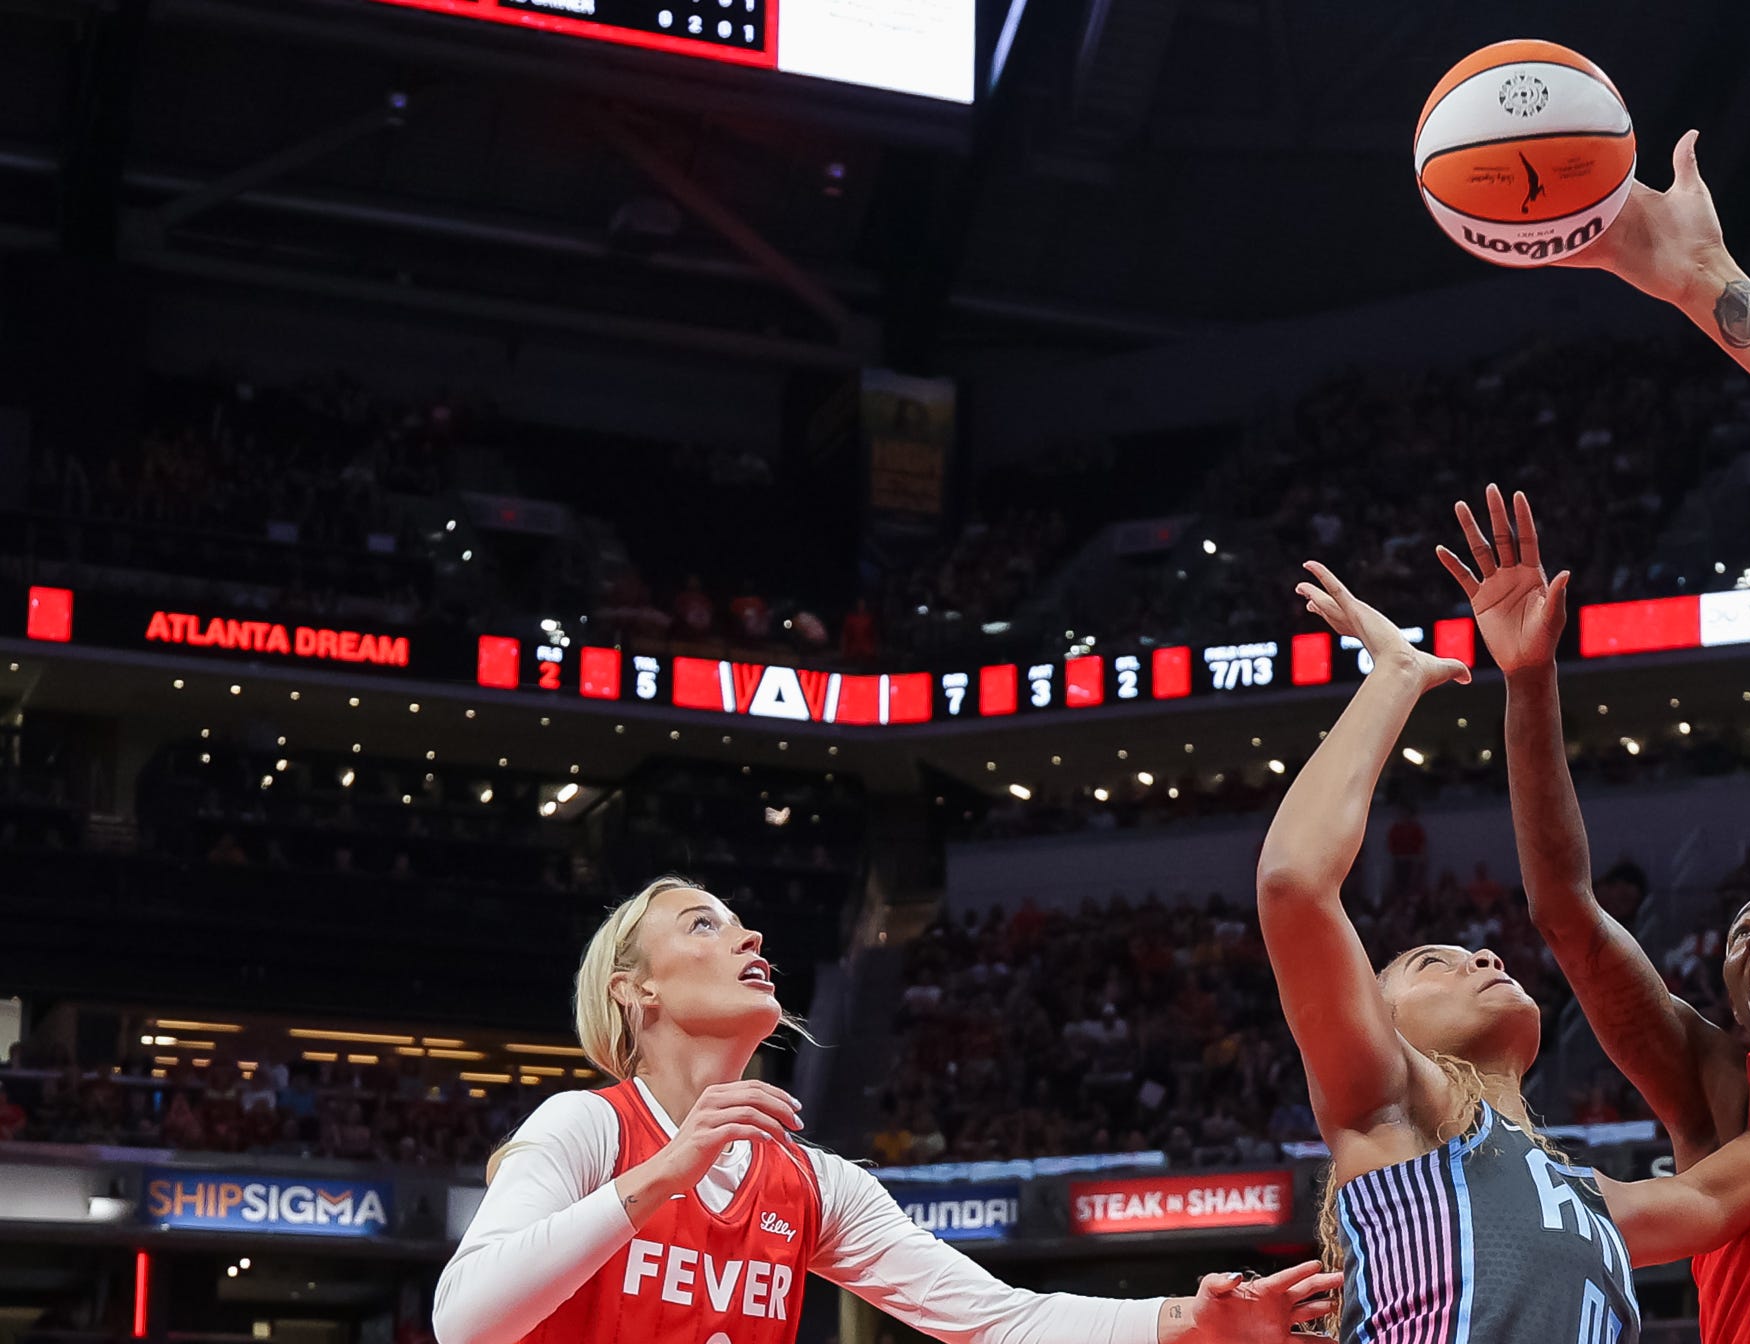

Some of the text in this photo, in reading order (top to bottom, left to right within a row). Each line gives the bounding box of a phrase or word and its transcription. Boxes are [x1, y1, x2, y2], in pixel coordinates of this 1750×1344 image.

[1462, 215, 1605, 261] Wilson
[145, 610, 411, 667] ATLANTA DREAM
[539, 661, 561, 690] 2
[636, 671, 658, 699] 5
[1117, 669, 1140, 699] 2
[1208, 657, 1274, 690] 7/13
[945, 686, 967, 716] 7
[1031, 679, 1052, 708] 3
[149, 1179, 387, 1227] SHIPSIGMA
[1074, 1190, 1165, 1223] STEAK
[1187, 1184, 1282, 1217] SHAKE
[760, 1210, 798, 1243] Lilly
[621, 1237, 794, 1321] FEVER
